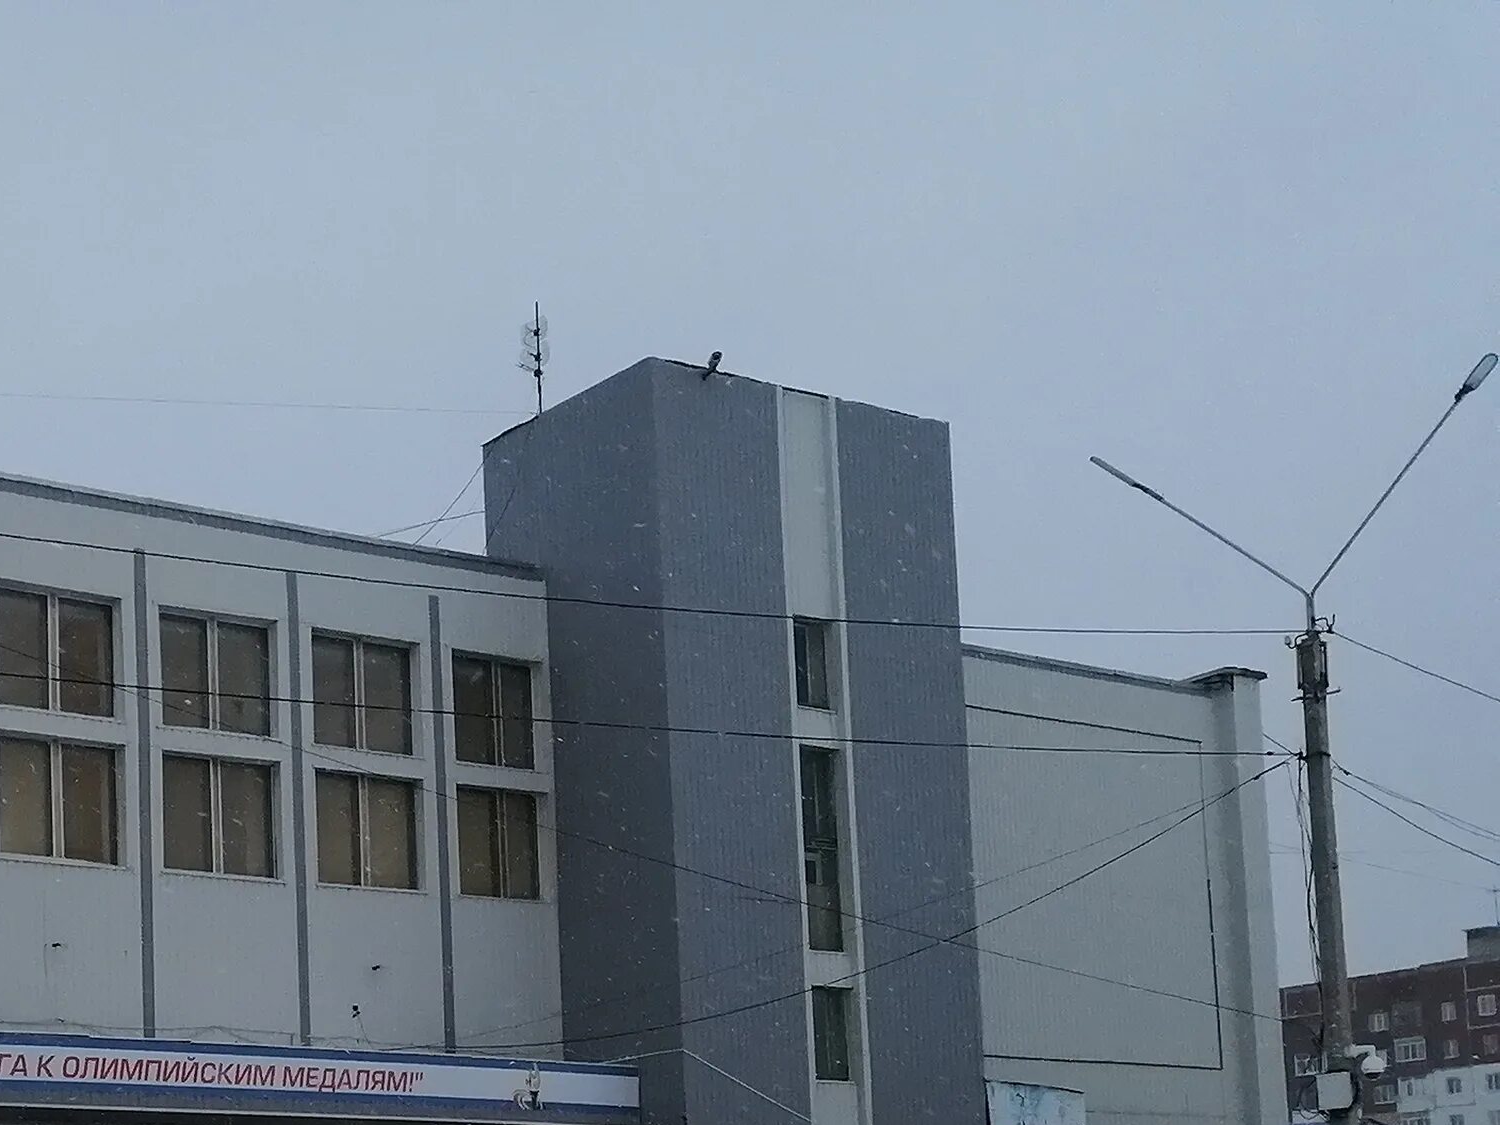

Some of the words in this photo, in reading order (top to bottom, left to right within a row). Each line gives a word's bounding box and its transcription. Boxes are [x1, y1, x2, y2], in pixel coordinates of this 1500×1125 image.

[36, 1054, 56, 1078] К
[62, 1055, 275, 1087] ОЛИМПИЙСКИМ
[282, 1065, 424, 1093] МЕДАЛЯМ!"
